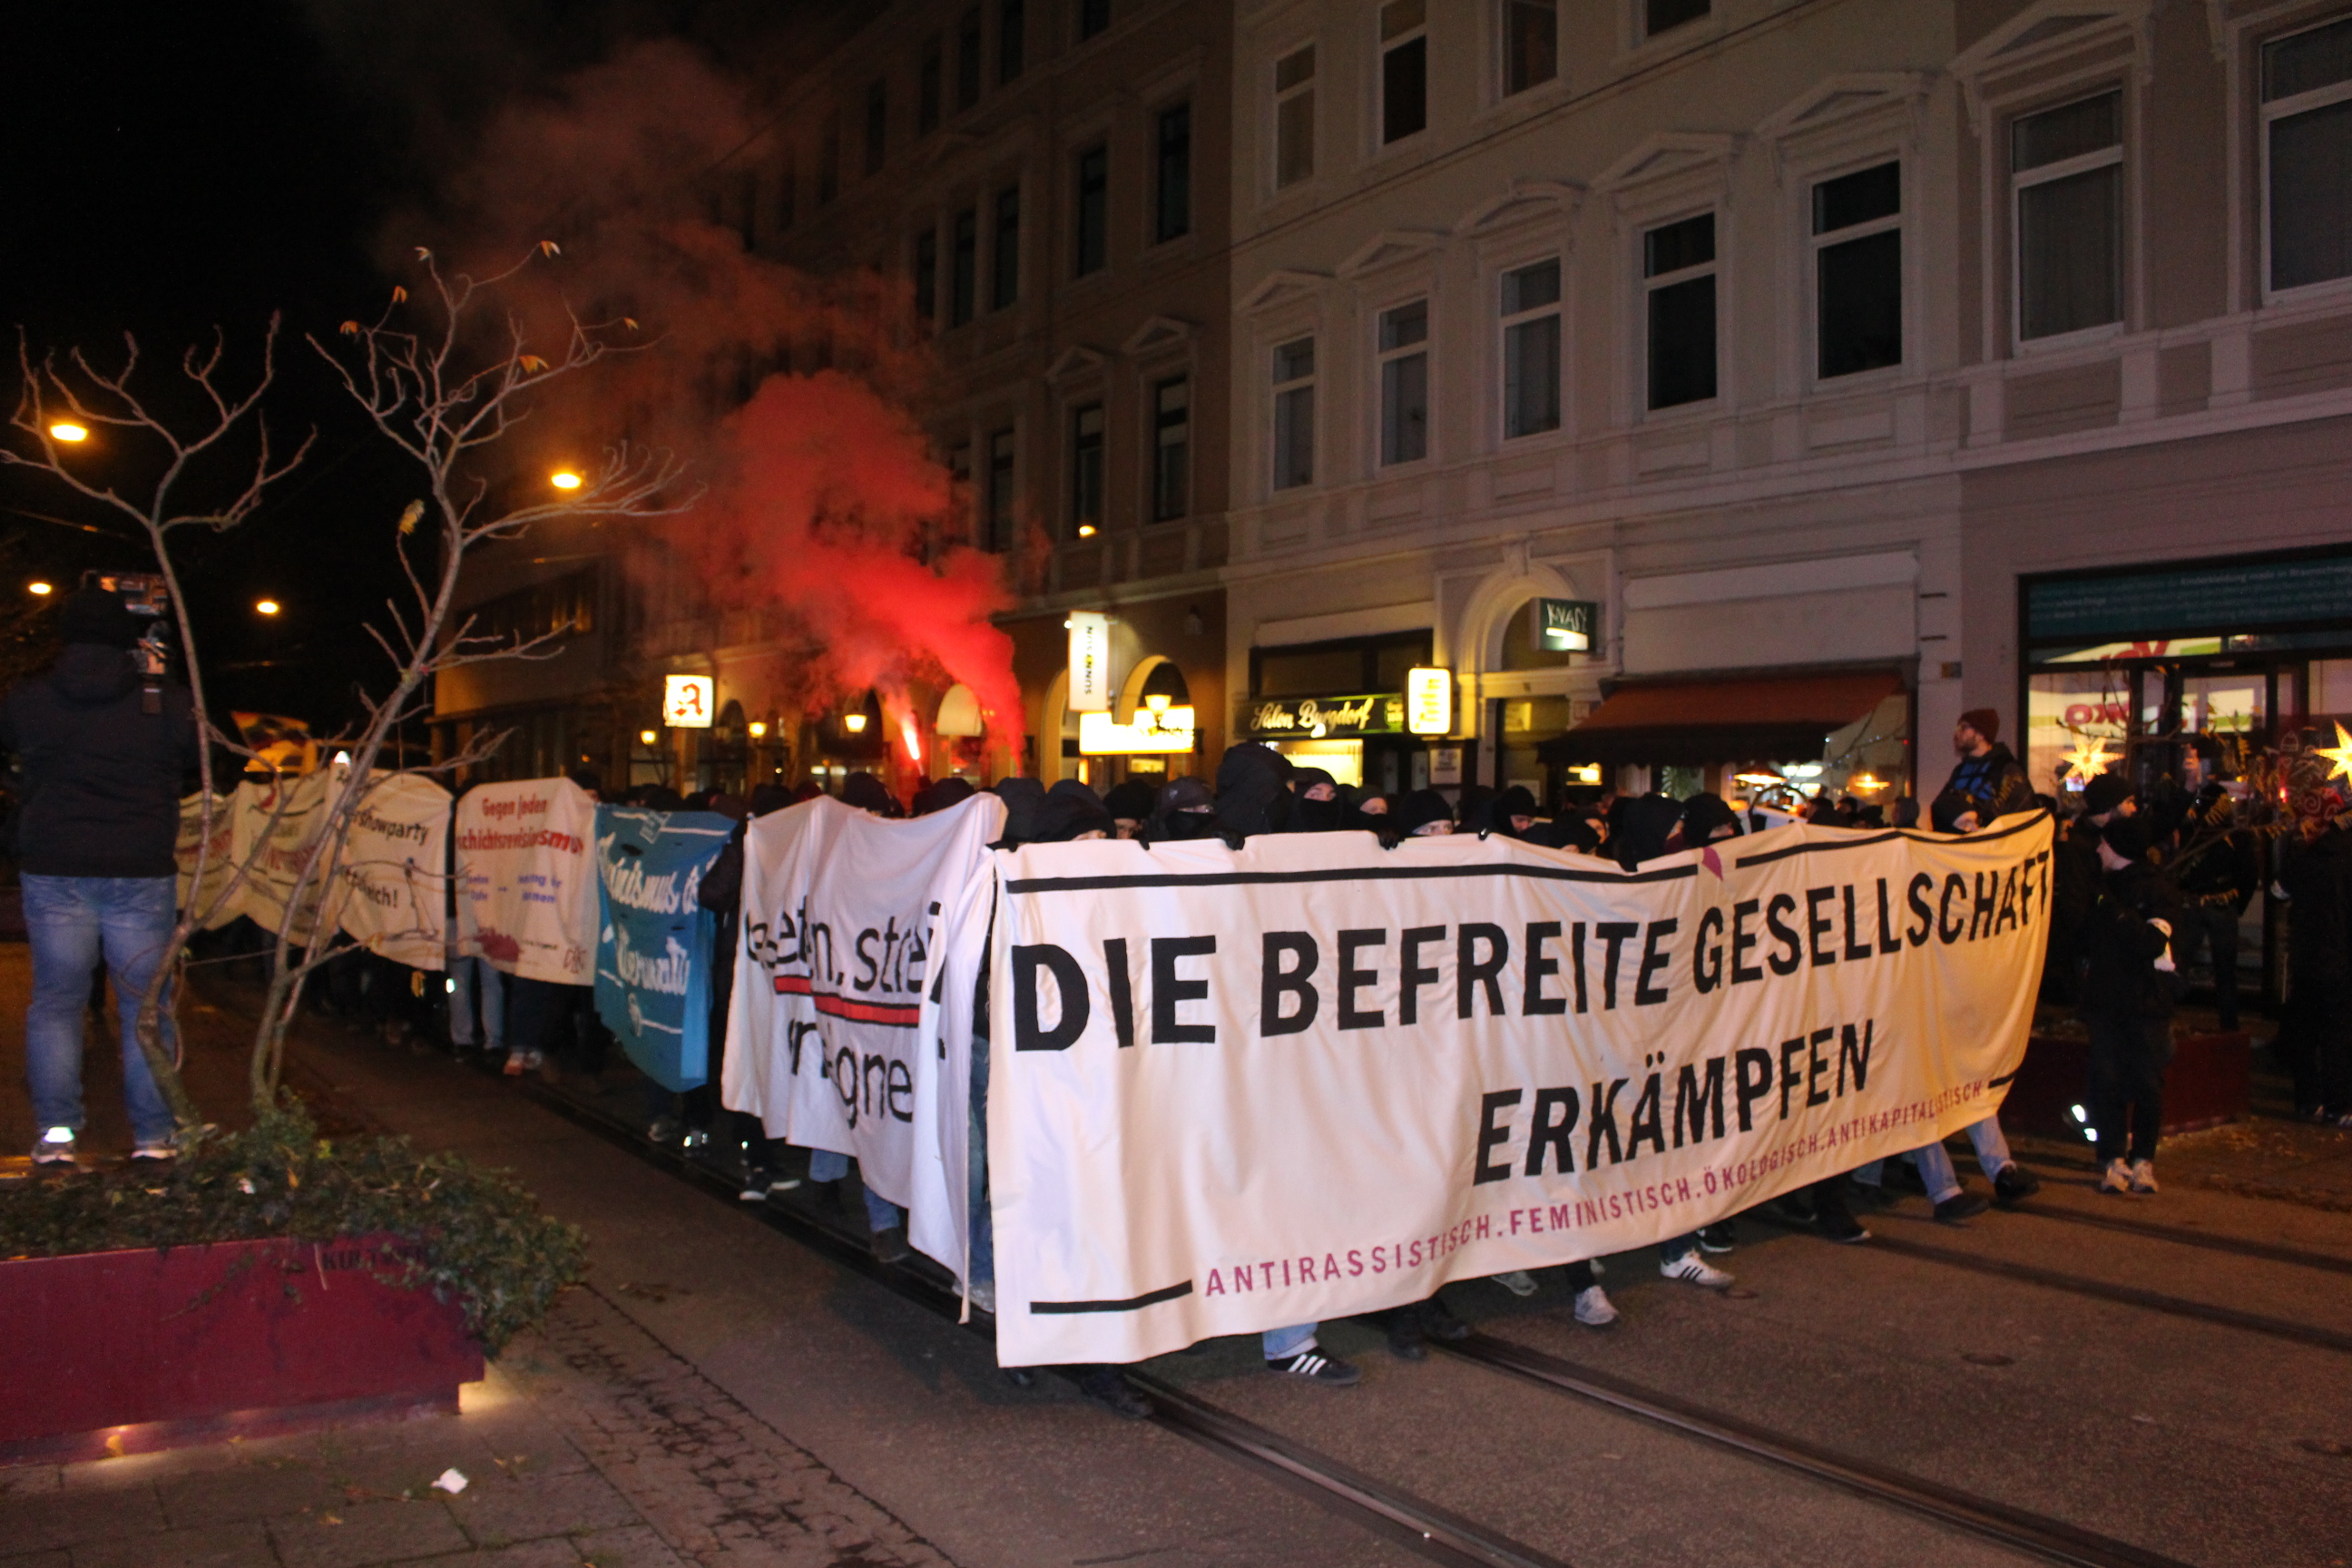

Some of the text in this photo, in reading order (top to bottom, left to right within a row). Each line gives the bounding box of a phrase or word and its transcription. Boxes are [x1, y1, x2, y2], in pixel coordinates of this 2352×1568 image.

[1251, 701, 1295, 730] Salon
[1298, 697, 1375, 731] Burgdorf
[1011, 849, 2050, 1052] DIE BEFREITE GESELLSCHAFT
[1473, 1018, 1874, 1187] ERKÄMPFEN
